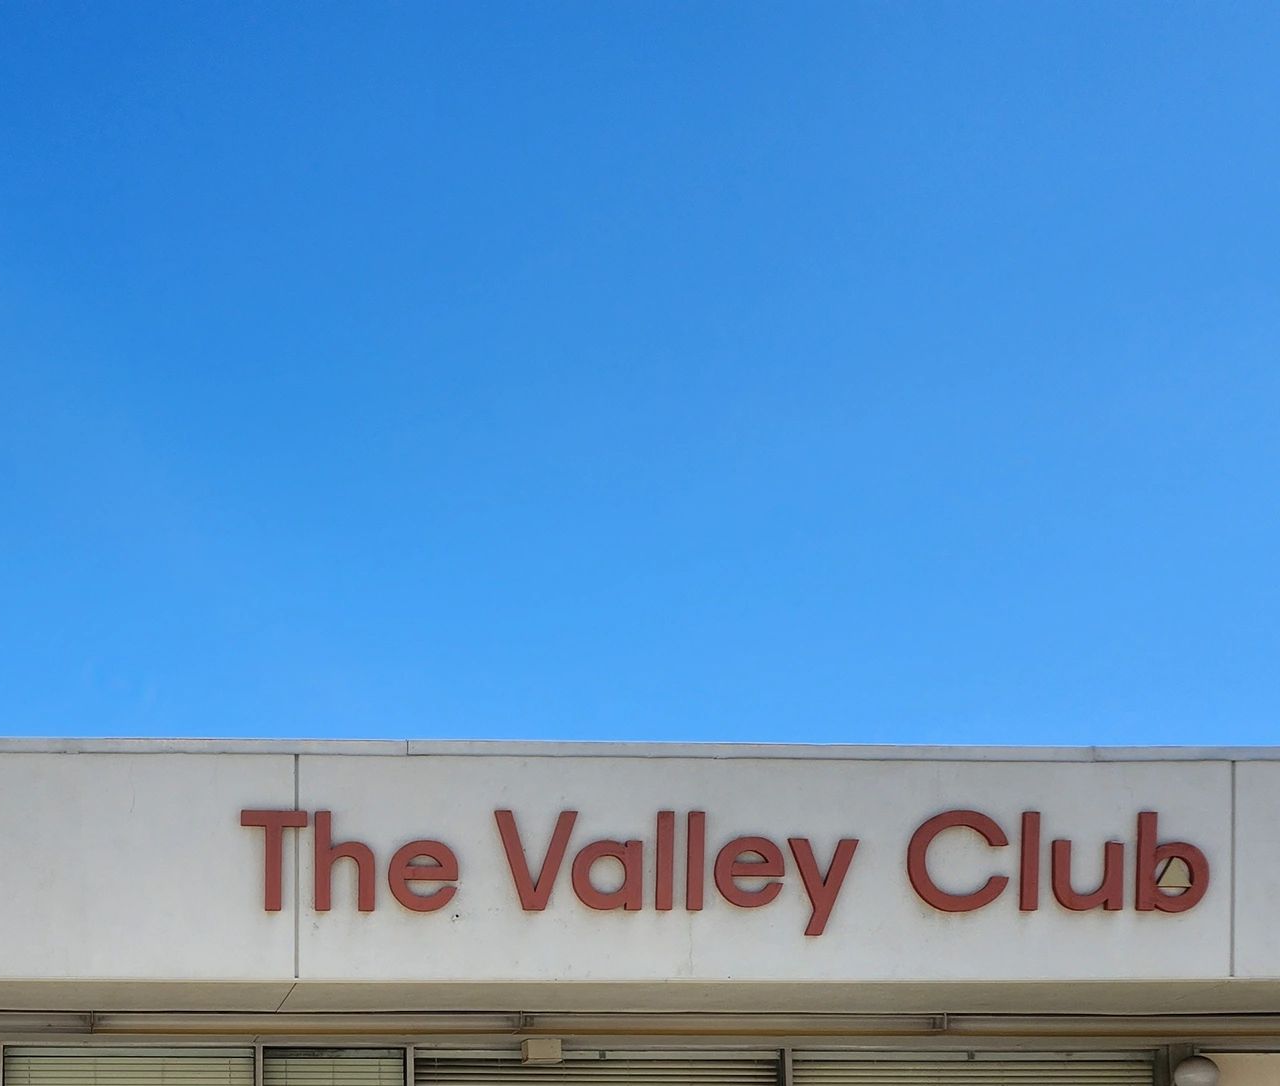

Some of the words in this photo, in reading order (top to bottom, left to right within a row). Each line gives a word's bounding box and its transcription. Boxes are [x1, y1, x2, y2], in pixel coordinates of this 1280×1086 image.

[240, 809, 460, 914] The
[494, 809, 860, 937] Valley
[906, 808, 1211, 914] Club
